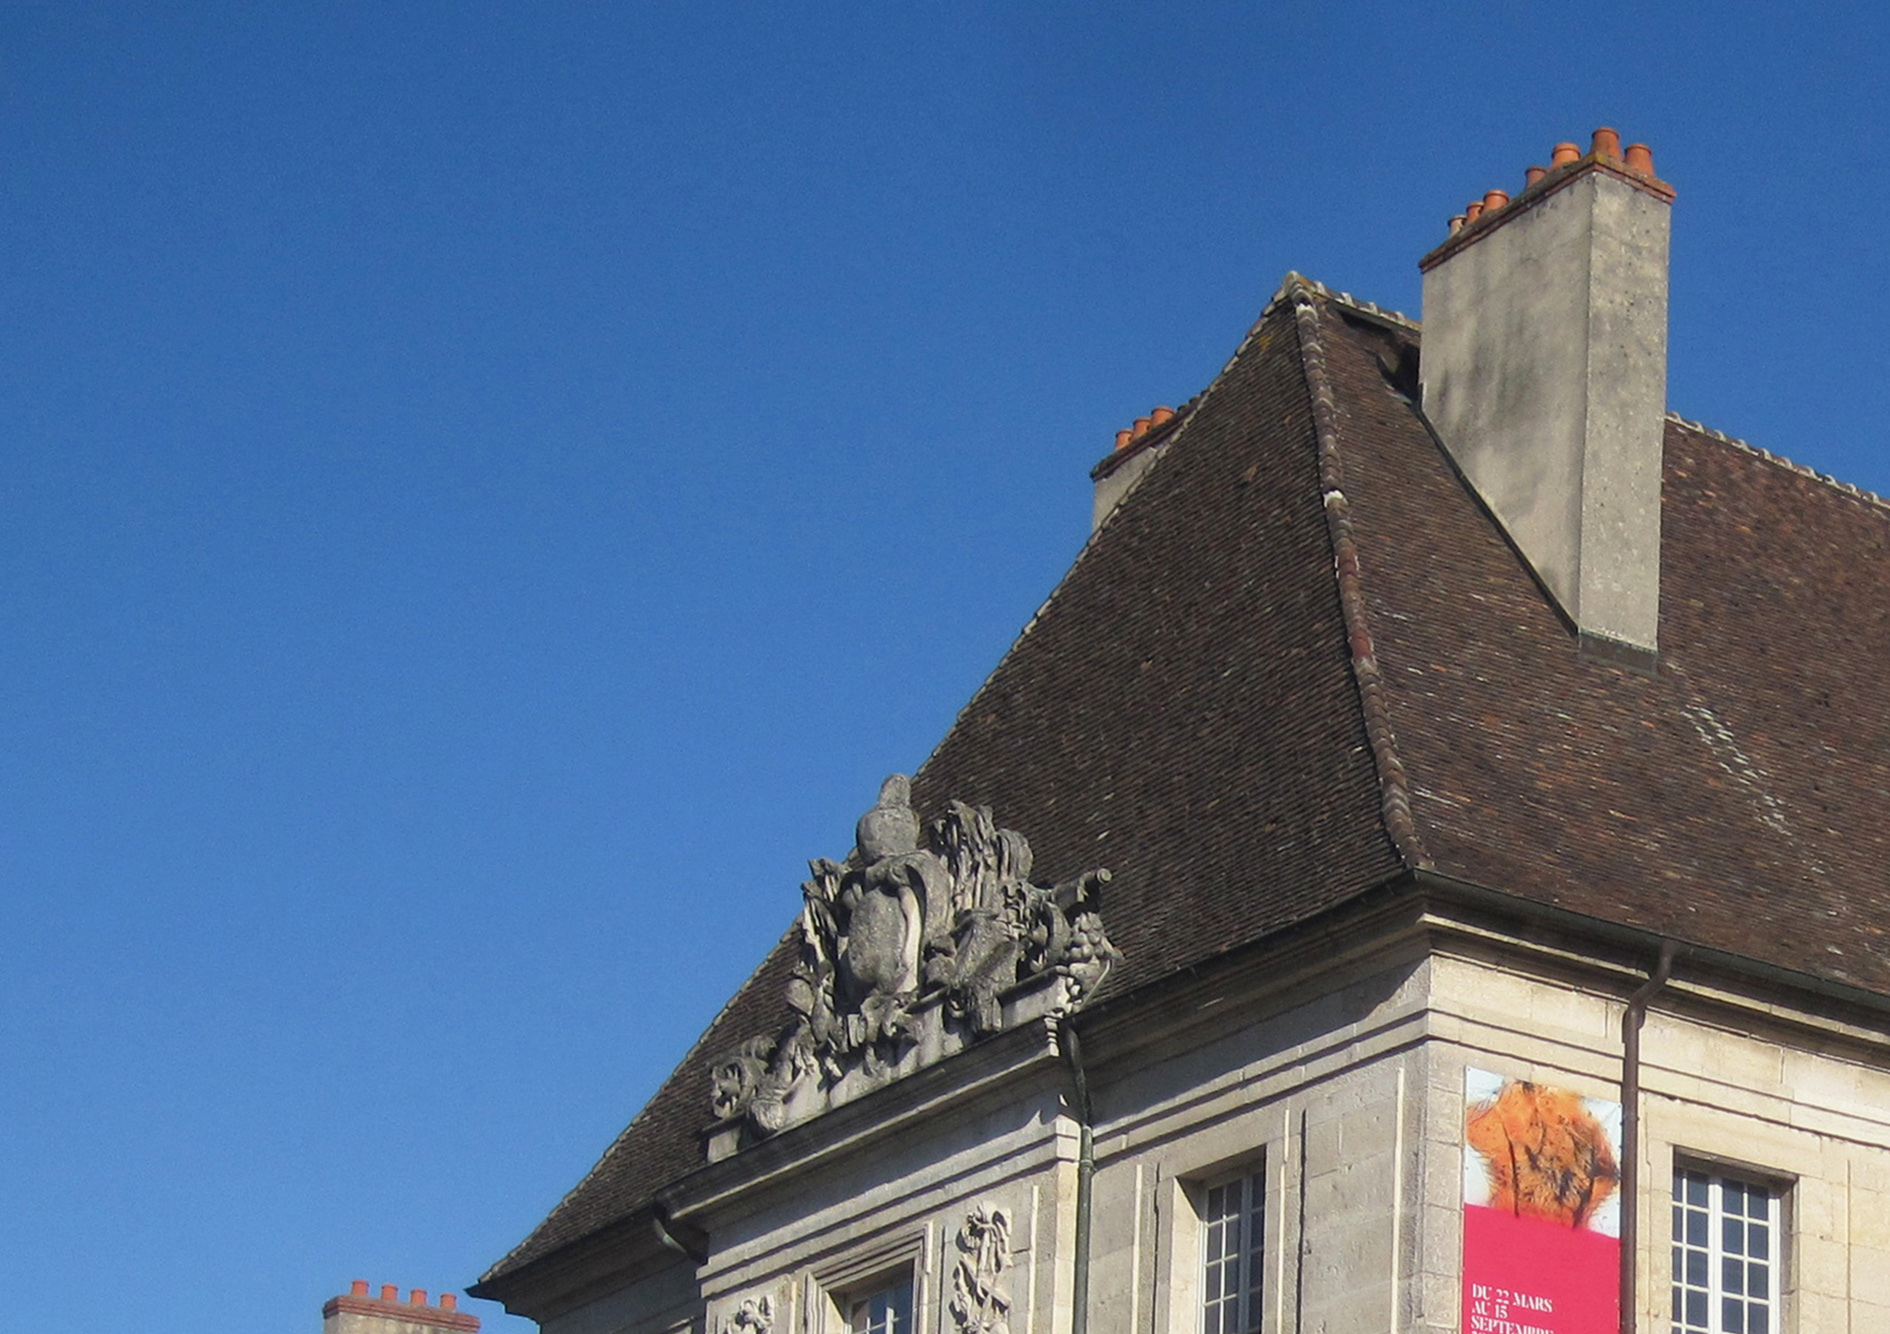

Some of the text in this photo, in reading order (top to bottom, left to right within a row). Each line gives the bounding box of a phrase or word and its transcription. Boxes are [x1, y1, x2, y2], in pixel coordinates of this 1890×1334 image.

[1472, 1284, 1553, 1312] DU 22 MARS
[1472, 1301, 1508, 1319] AU 15
